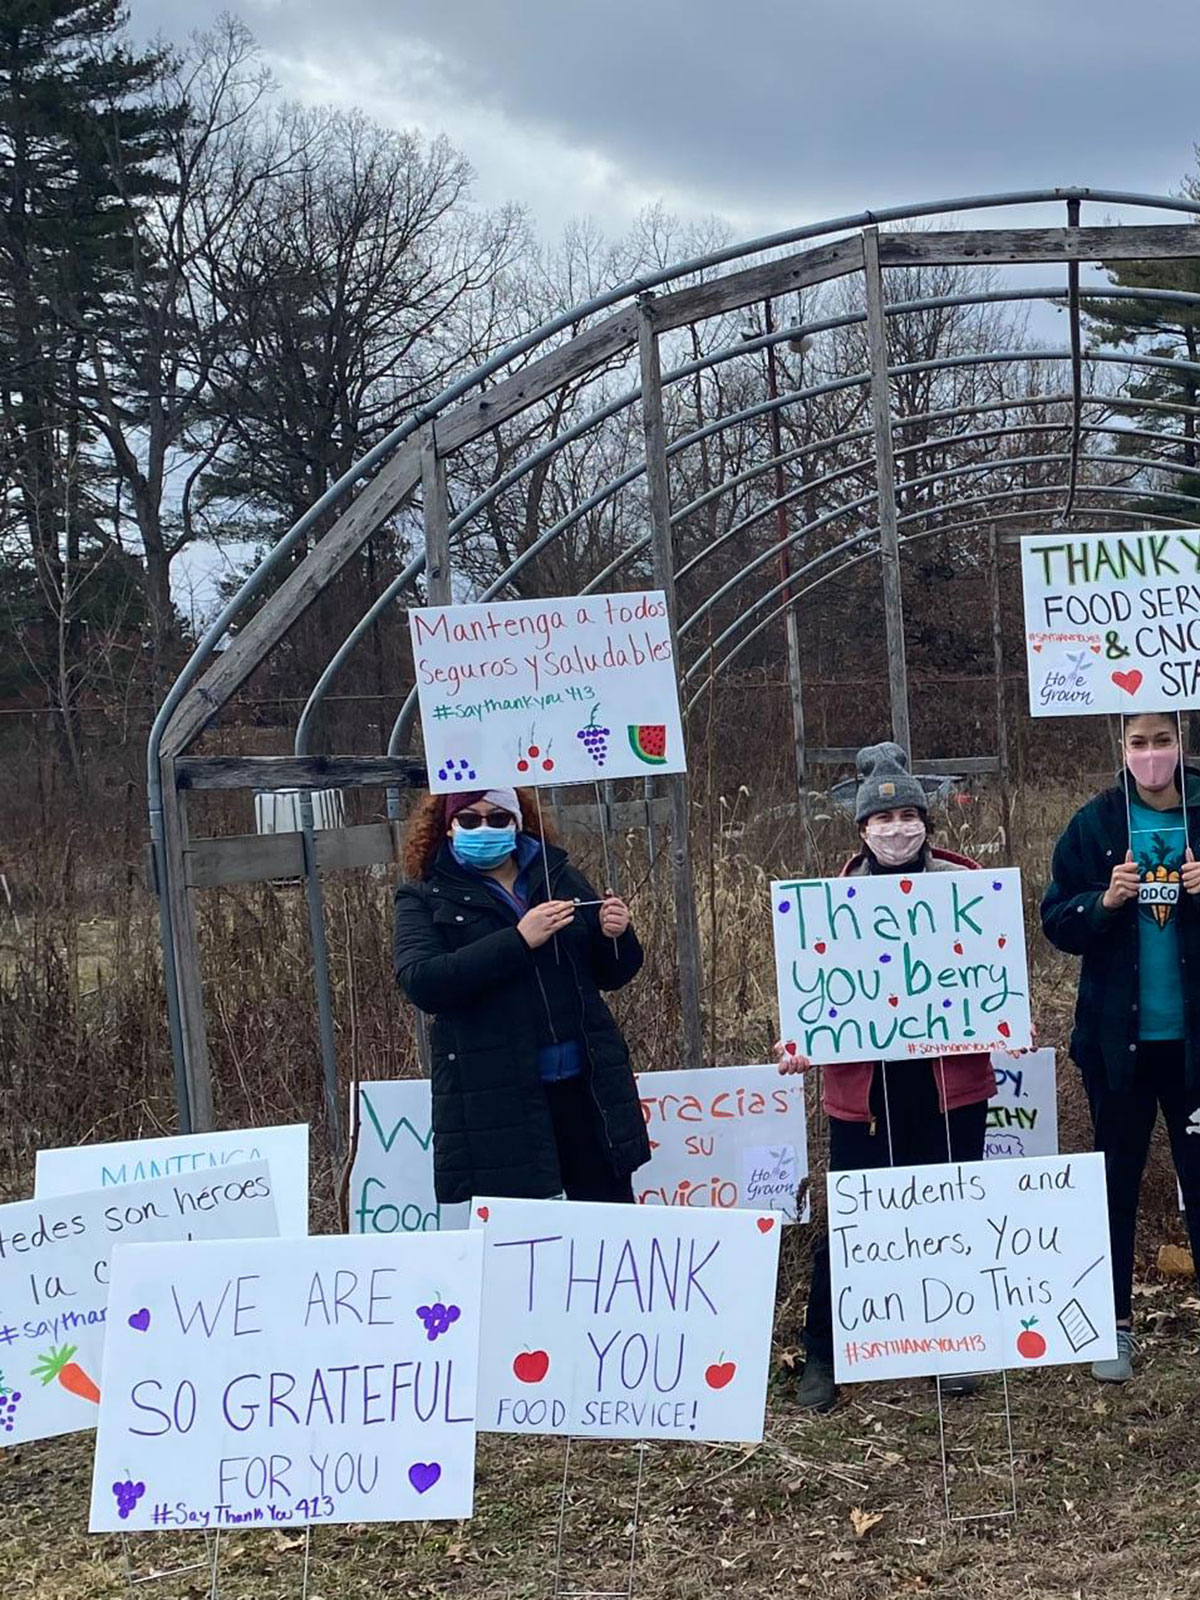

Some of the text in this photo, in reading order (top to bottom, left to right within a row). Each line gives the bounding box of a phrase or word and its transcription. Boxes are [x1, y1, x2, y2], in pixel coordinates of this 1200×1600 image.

[1030, 535, 1180, 586] THANK
[414, 596, 666, 650] Mantenga a todos
[1044, 590, 1132, 627] FOOD
[1105, 630, 1131, 660] &
[419, 657, 518, 696] Seguros
[1040, 684, 1094, 705] Grown
[780, 881, 984, 950] Thank
[792, 942, 1024, 1024] you berry
[804, 998, 976, 1056] much!
[355, 1177, 440, 1233] food
[638, 1177, 738, 1207] rvicio
[747, 1181, 795, 1200] Grown
[836, 1164, 1075, 1215] Students and
[0, 1176, 271, 1258] tedes son héroes
[832, 1215, 1061, 1268] Teachers, You
[30, 1274, 78, 1305] la
[493, 1236, 720, 1315] THANK
[838, 1267, 1052, 1331] Can Do This
[172, 1269, 397, 1338] WE ARE
[588, 1330, 684, 1392] YOU
[129, 1360, 474, 1436] SO GRATEFUL
[497, 1398, 698, 1431] FOOD SERVICE!
[219, 1452, 378, 1502] FOR YOU
